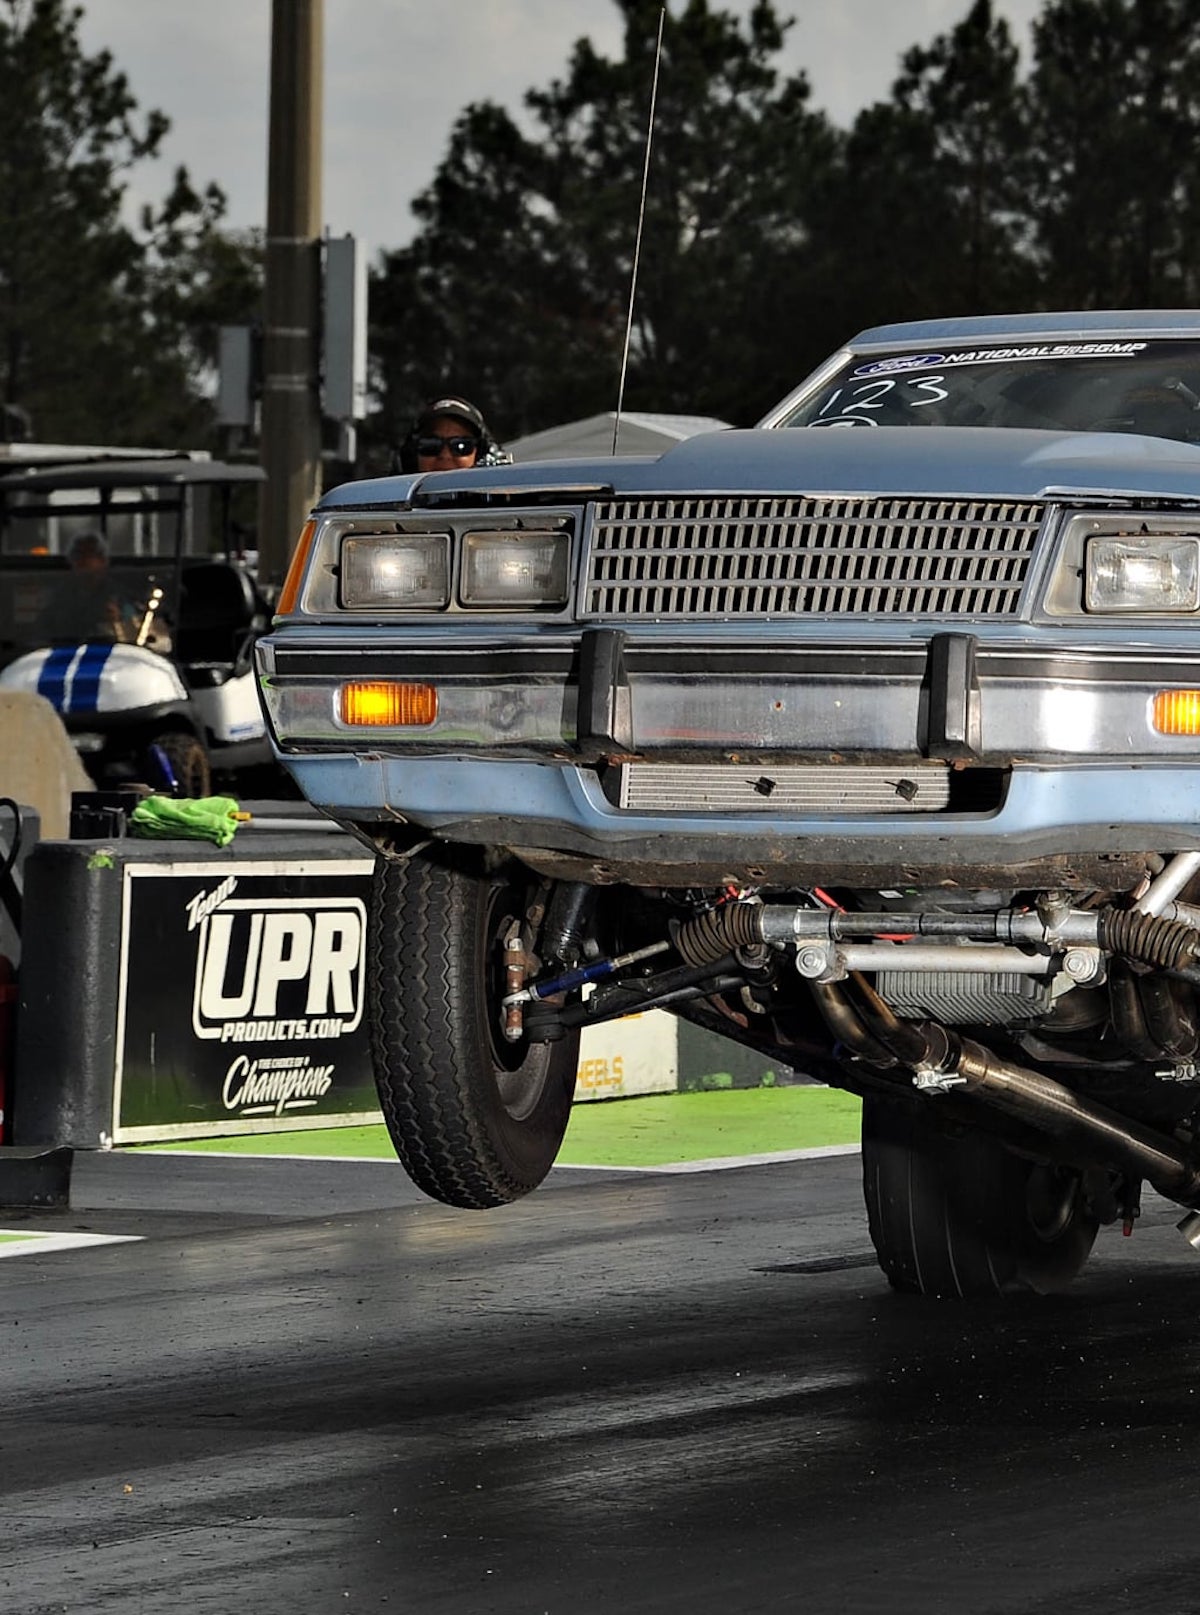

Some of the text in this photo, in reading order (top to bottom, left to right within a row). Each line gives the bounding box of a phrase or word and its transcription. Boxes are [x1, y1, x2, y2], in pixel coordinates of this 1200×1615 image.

[866, 356, 931, 374] Ford
[186, 875, 238, 931] Team
[201, 912, 361, 1019] UPR
[221, 1018, 343, 1042] PRODUCTS.COM
[223, 1055, 335, 1116] Champions
